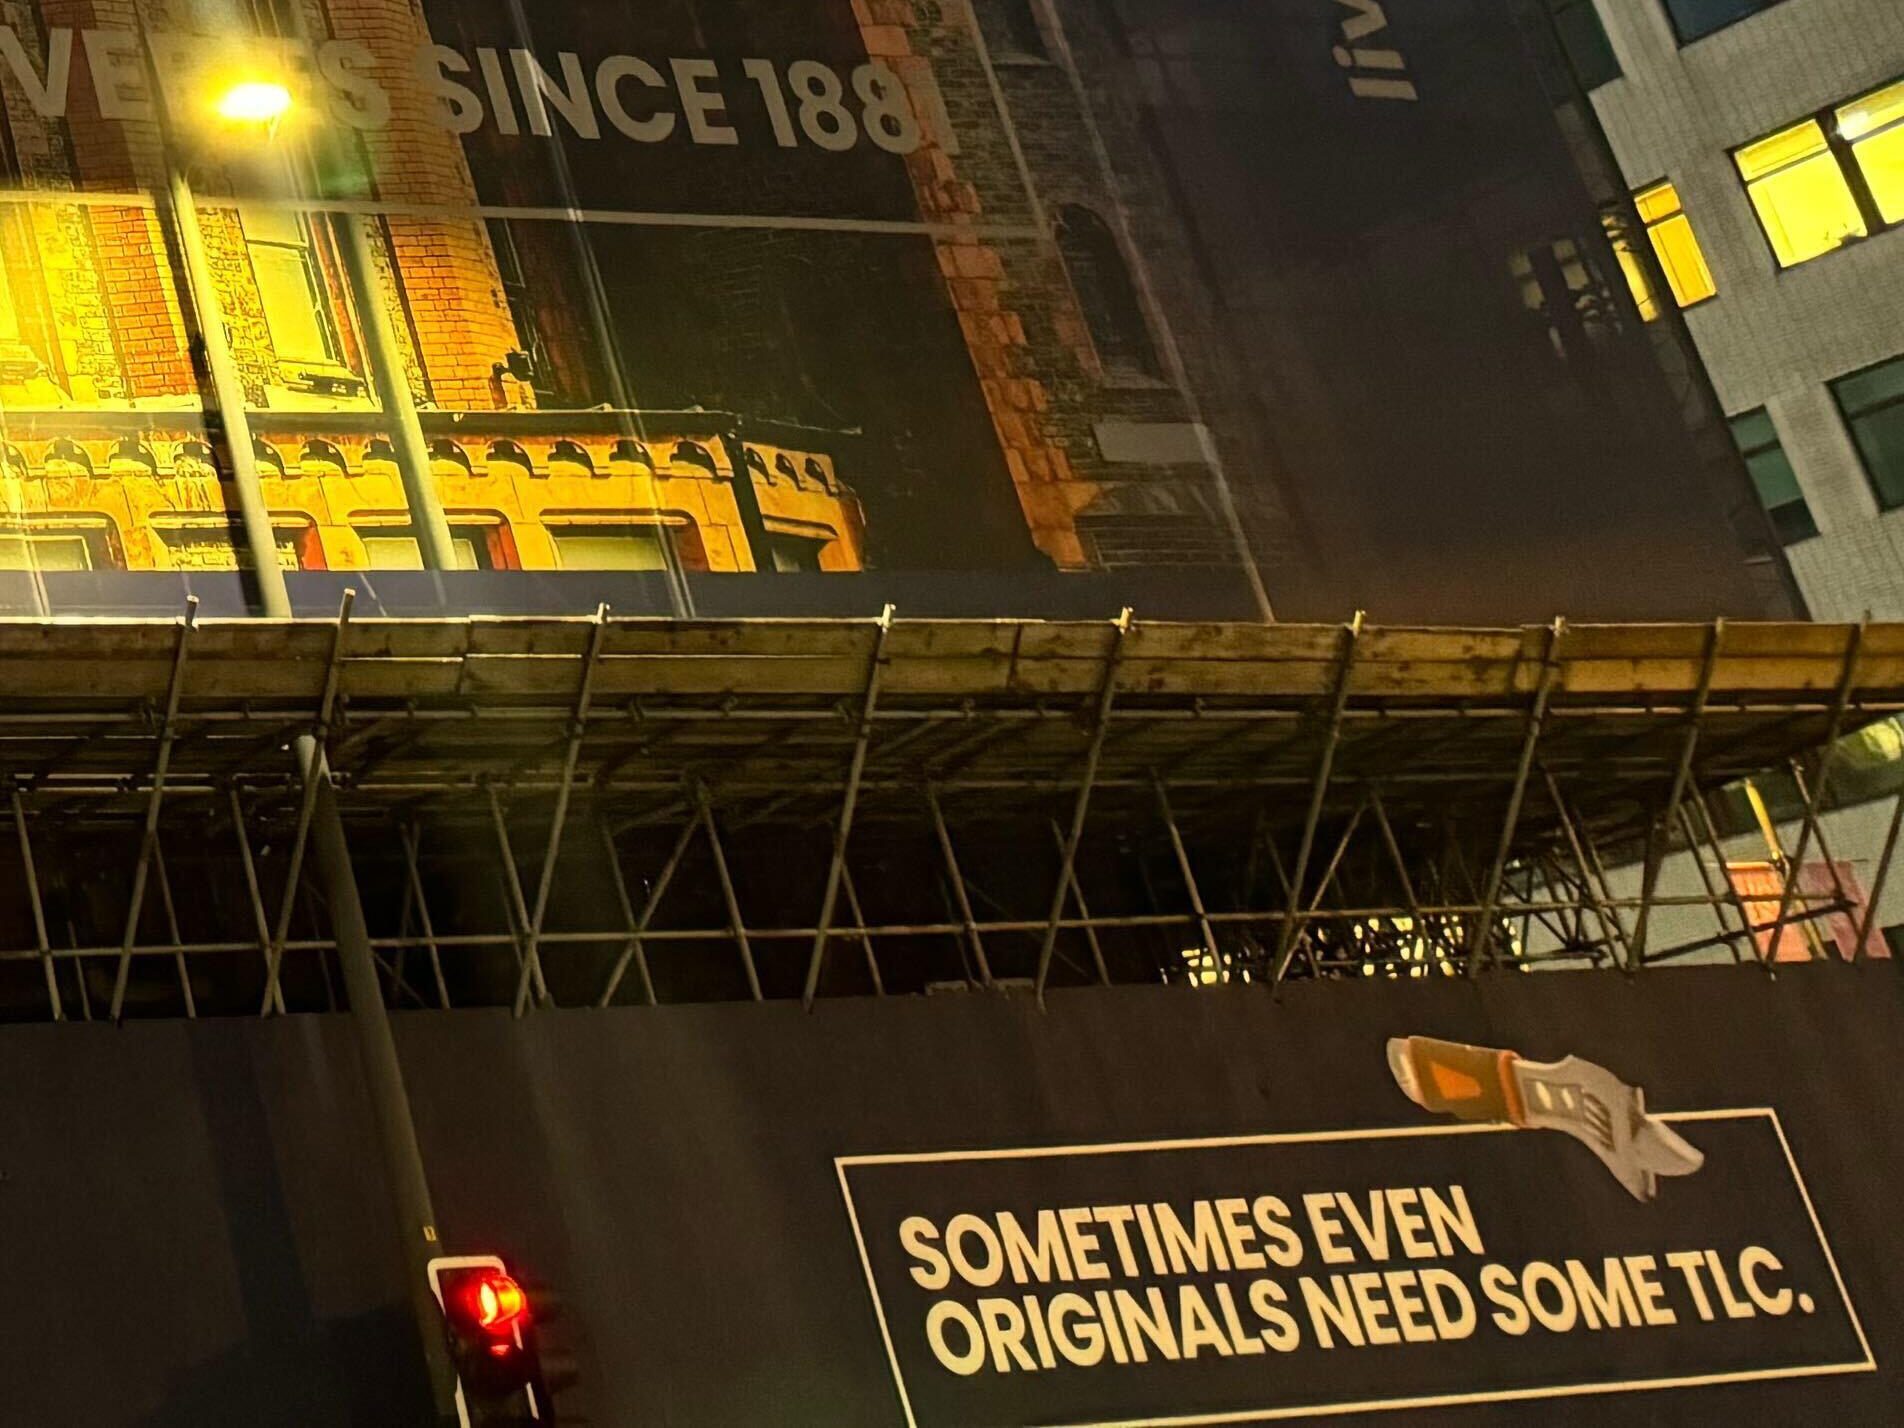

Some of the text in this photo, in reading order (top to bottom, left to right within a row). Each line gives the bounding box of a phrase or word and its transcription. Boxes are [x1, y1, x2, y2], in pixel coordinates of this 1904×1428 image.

[415, 41, 740, 146] SINCE
[899, 1185, 1486, 1292] SOMETIMES EVEN
[926, 1245, 1815, 1376] ORIGINALS NEED SOME TLC.
